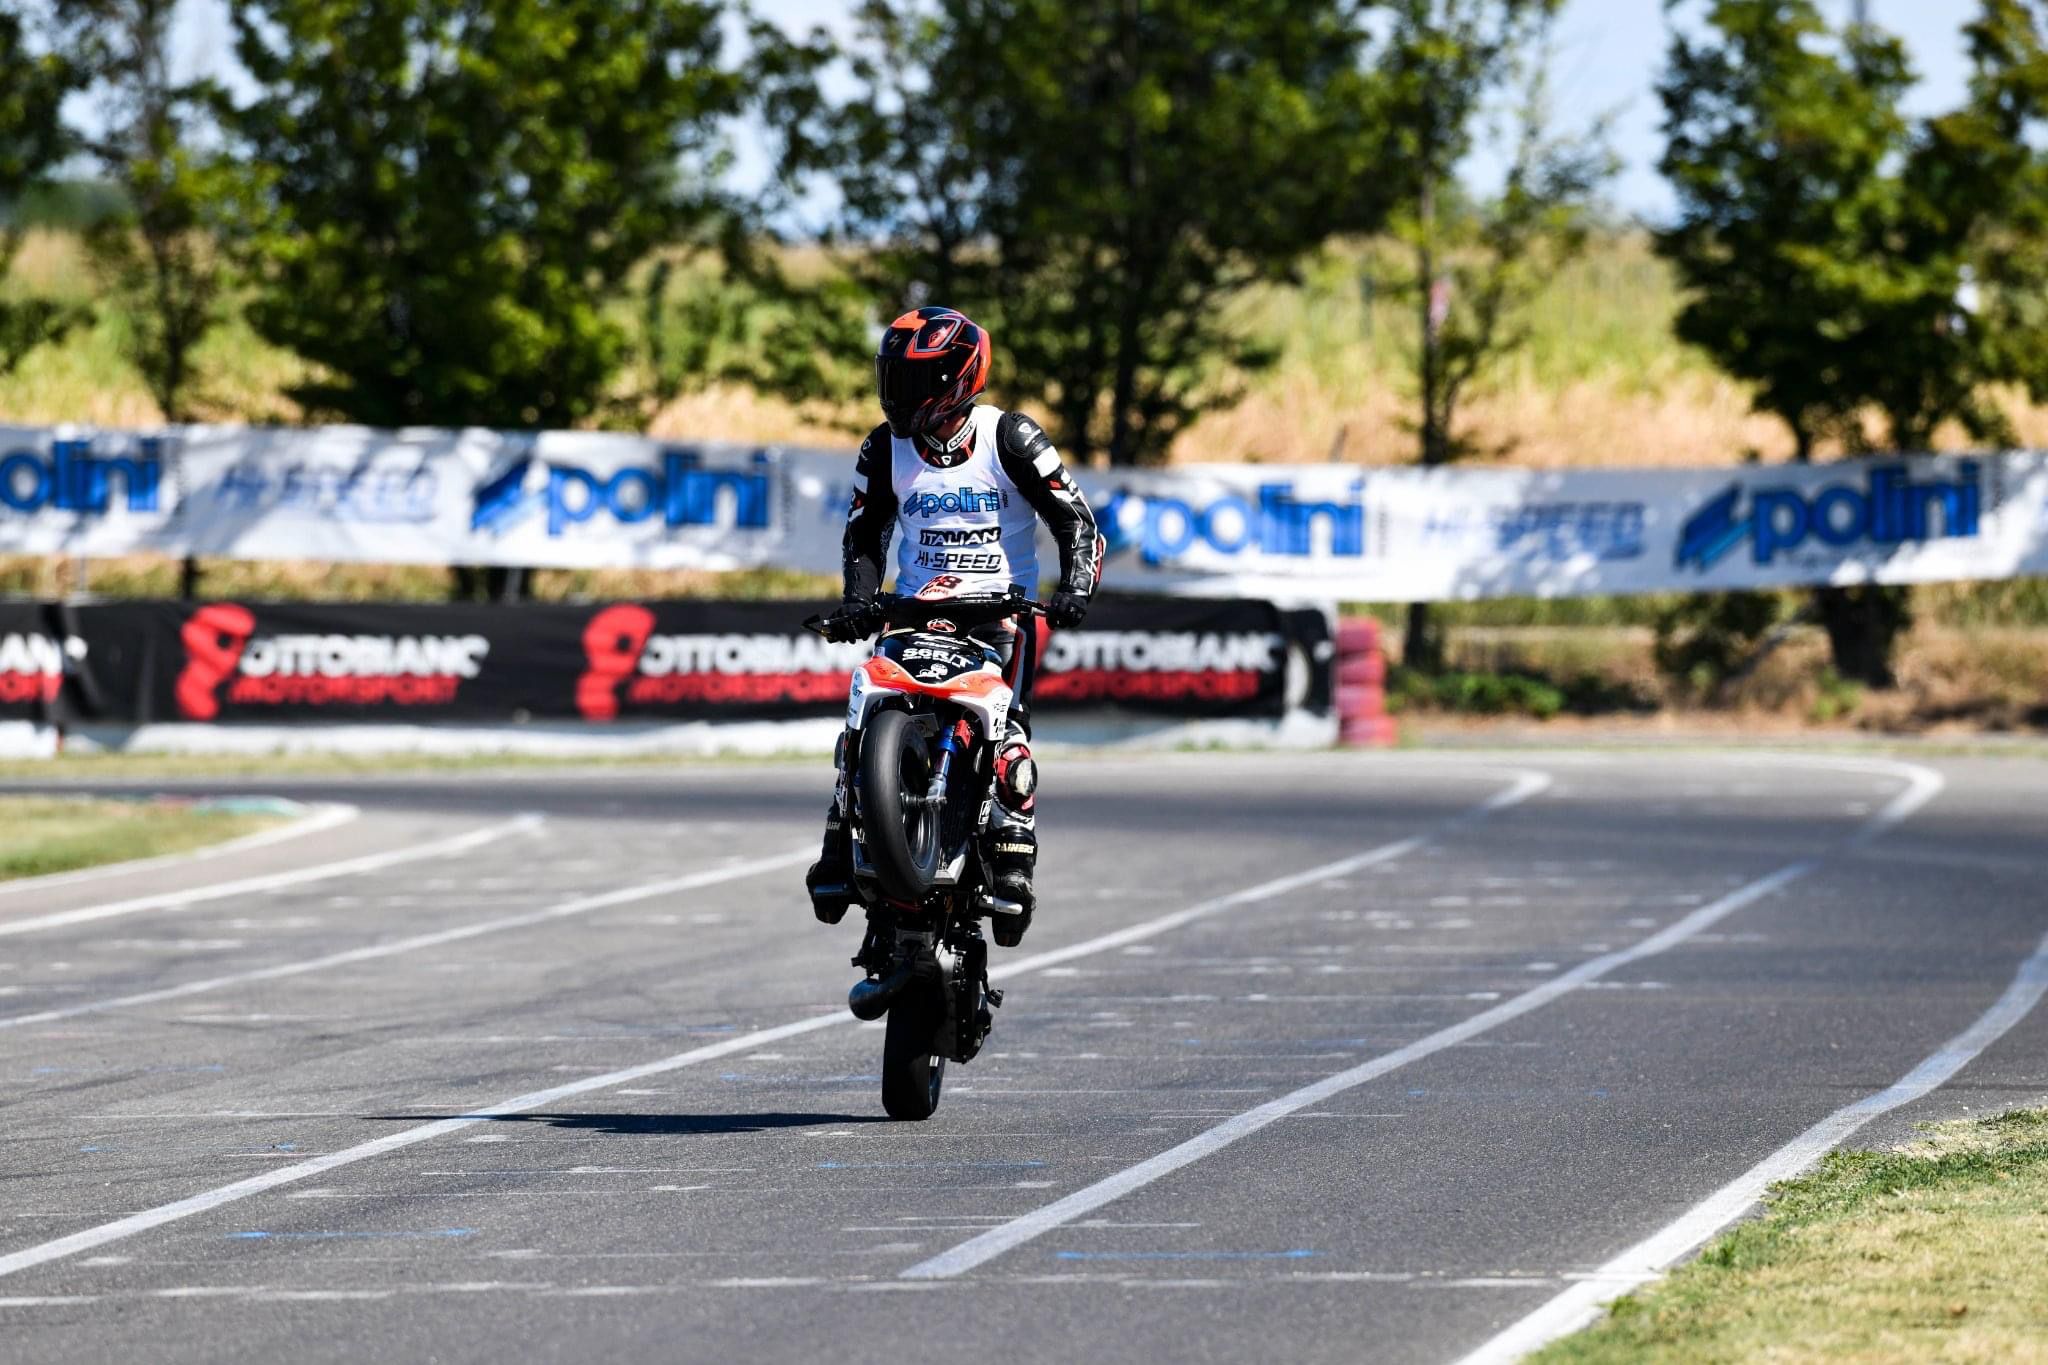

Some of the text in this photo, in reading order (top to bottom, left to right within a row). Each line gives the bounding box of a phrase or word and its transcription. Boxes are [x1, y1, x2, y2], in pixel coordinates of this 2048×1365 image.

[548, 449, 768, 536] polini
[921, 487, 1000, 518] polini
[1142, 477, 1364, 567] polini
[1753, 459, 1980, 564] polini
[914, 550, 1002, 570] HI-SPEED
[921, 528, 1000, 547] ITALIAN
